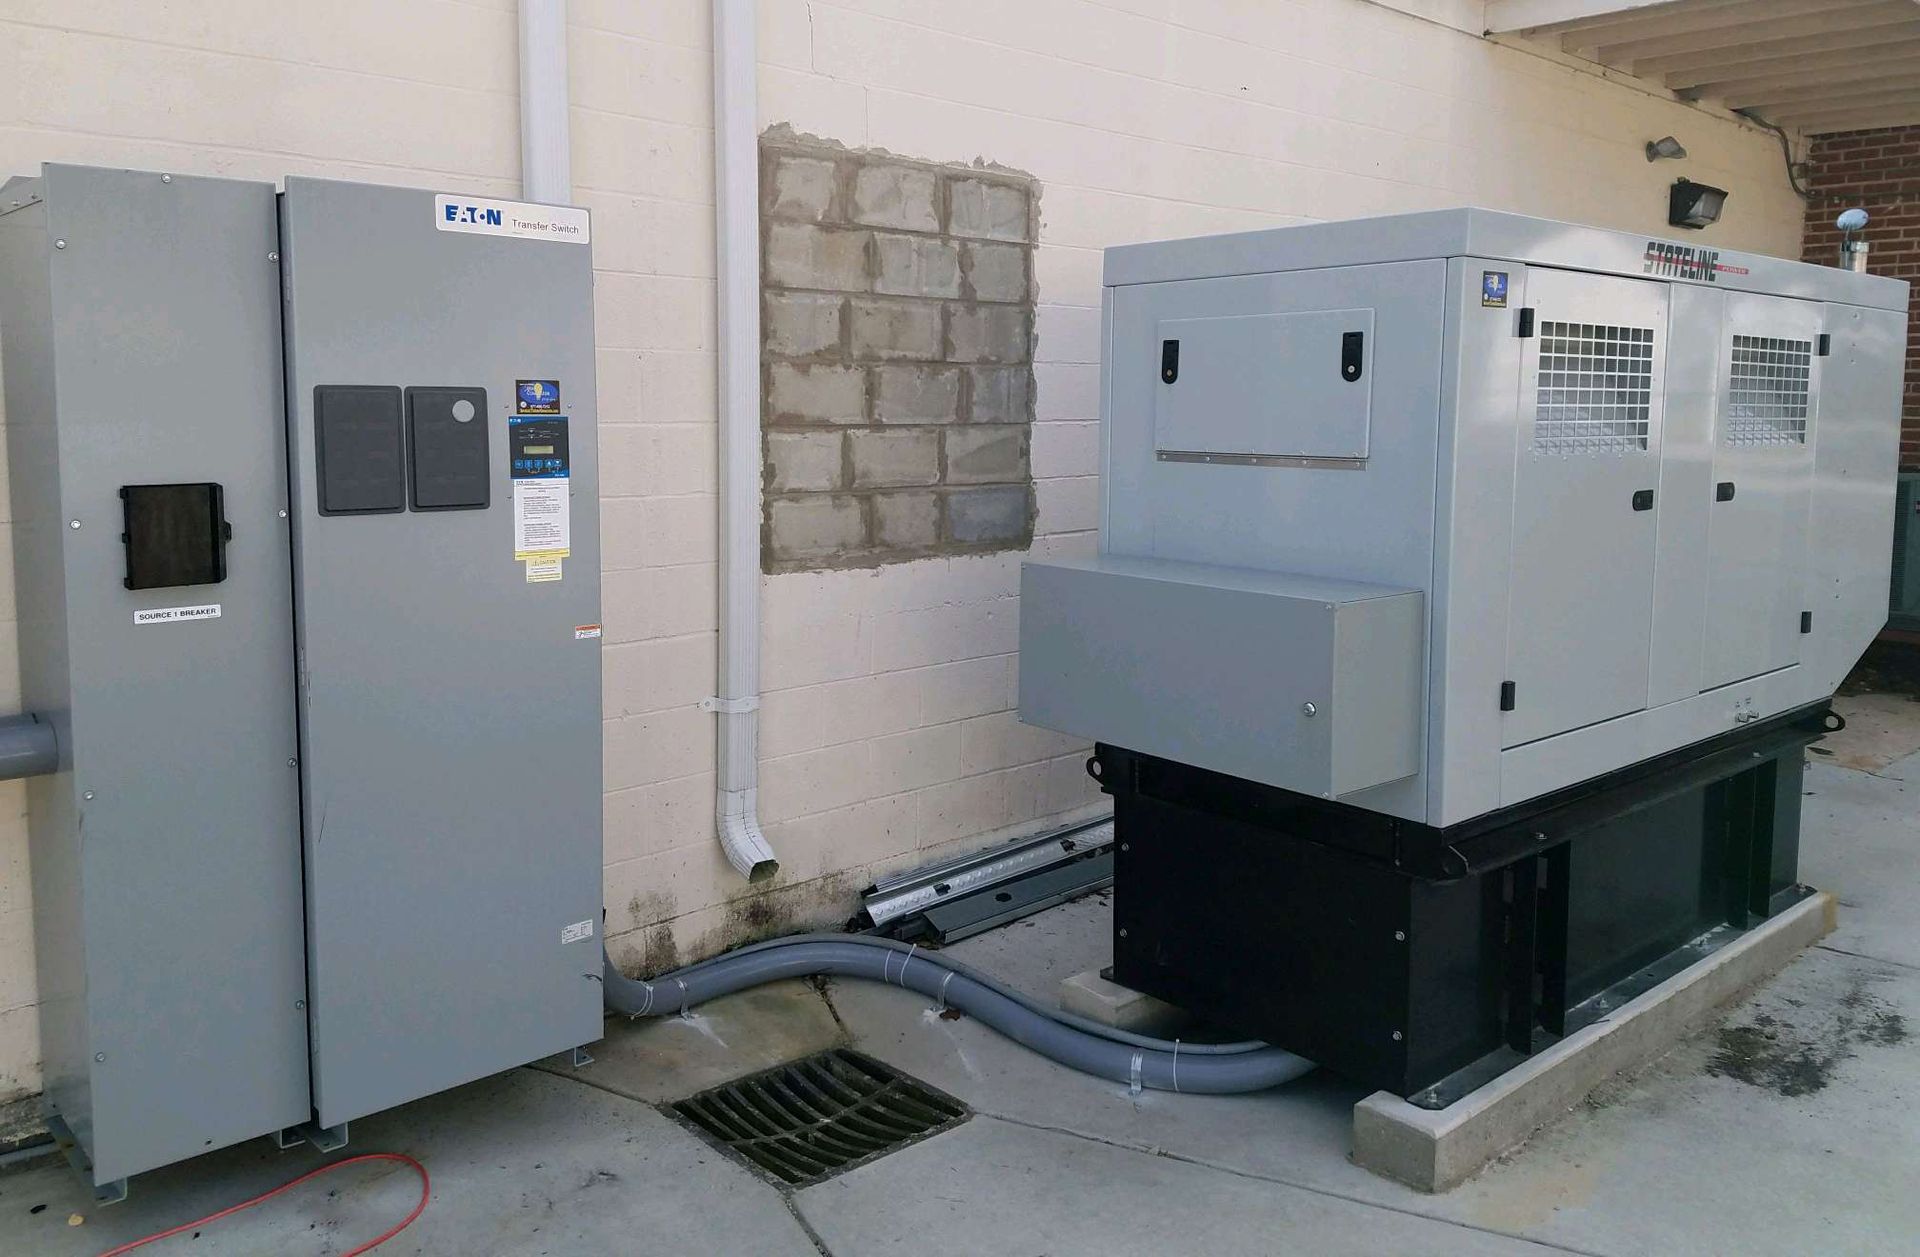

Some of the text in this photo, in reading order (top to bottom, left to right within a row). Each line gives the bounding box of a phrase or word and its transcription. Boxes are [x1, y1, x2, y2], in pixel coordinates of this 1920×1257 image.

[512, 219, 549, 231] Transfer
[551, 224, 579, 234] Switch
[1644, 241, 1719, 282] STATELINE
[139, 611, 172, 620] SOURCE
[180, 608, 216, 617] BREAKER
